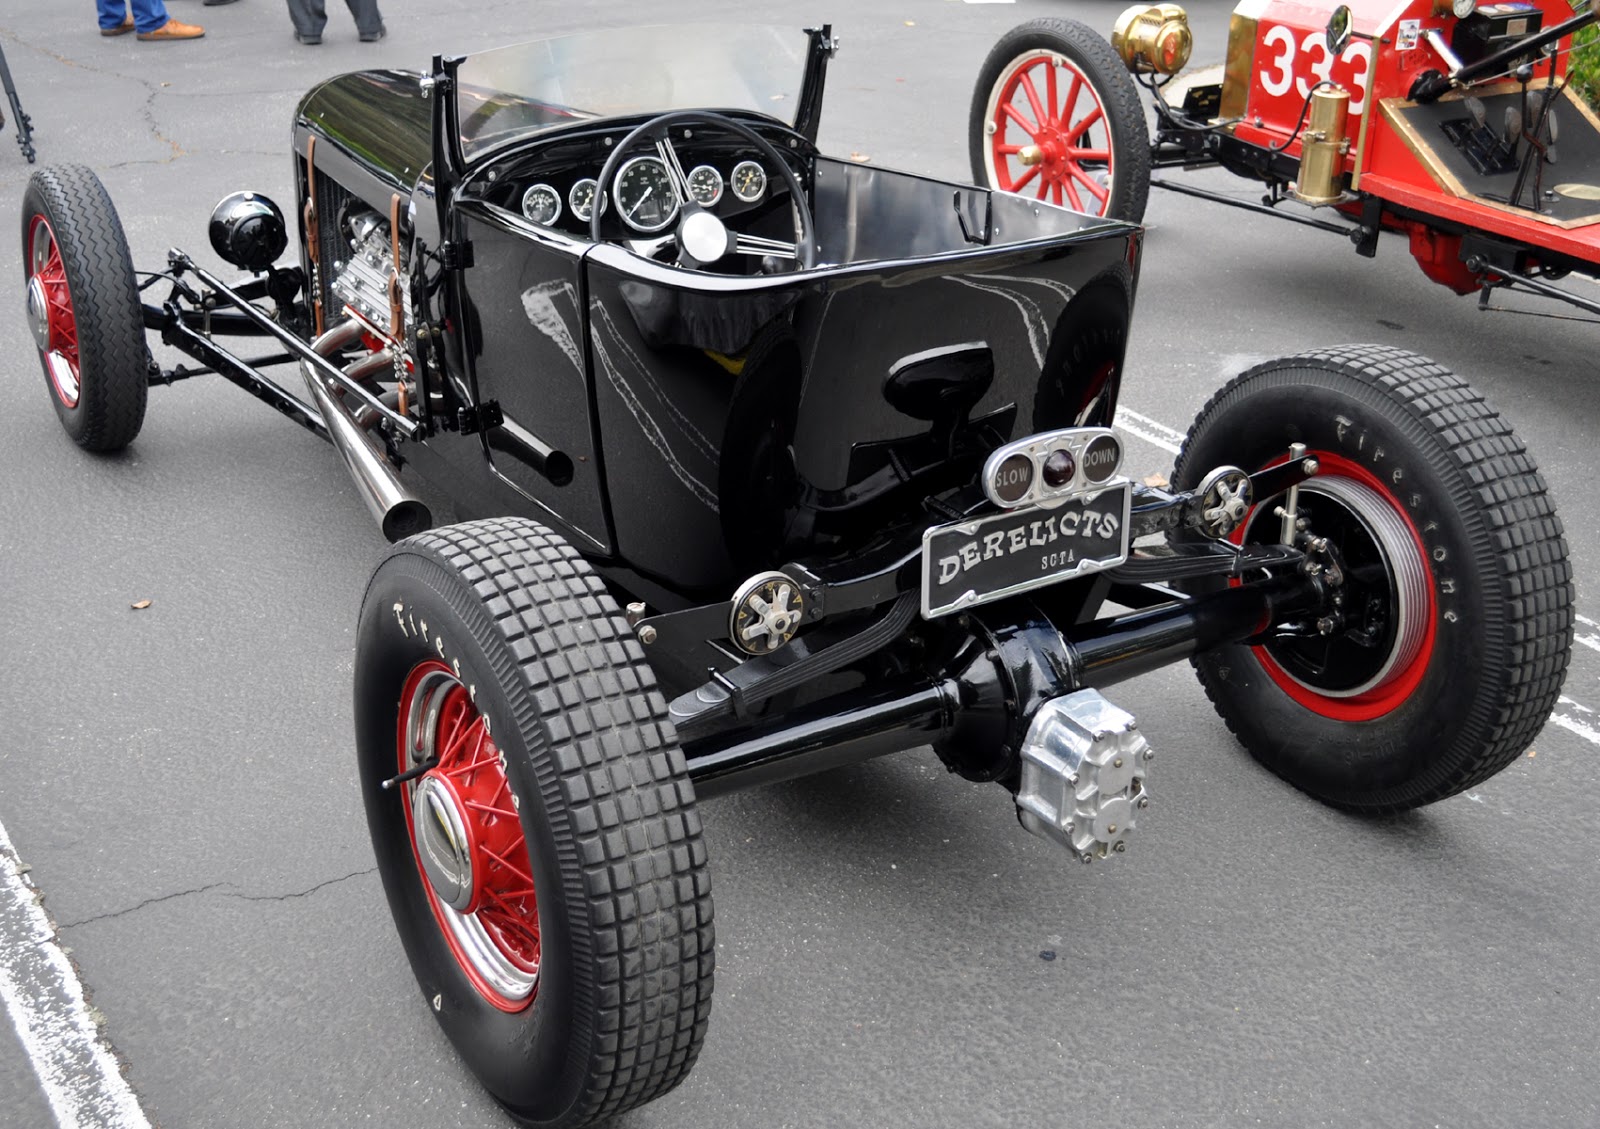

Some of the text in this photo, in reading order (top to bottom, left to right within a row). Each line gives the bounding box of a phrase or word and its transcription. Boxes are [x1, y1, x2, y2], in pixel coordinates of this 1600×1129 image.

[1260, 25, 1372, 115] 333
[995, 448, 1115, 488] SLOW DOWN
[938, 510, 1119, 585] DERELICTS
[1041, 549, 1075, 570] SCTA
